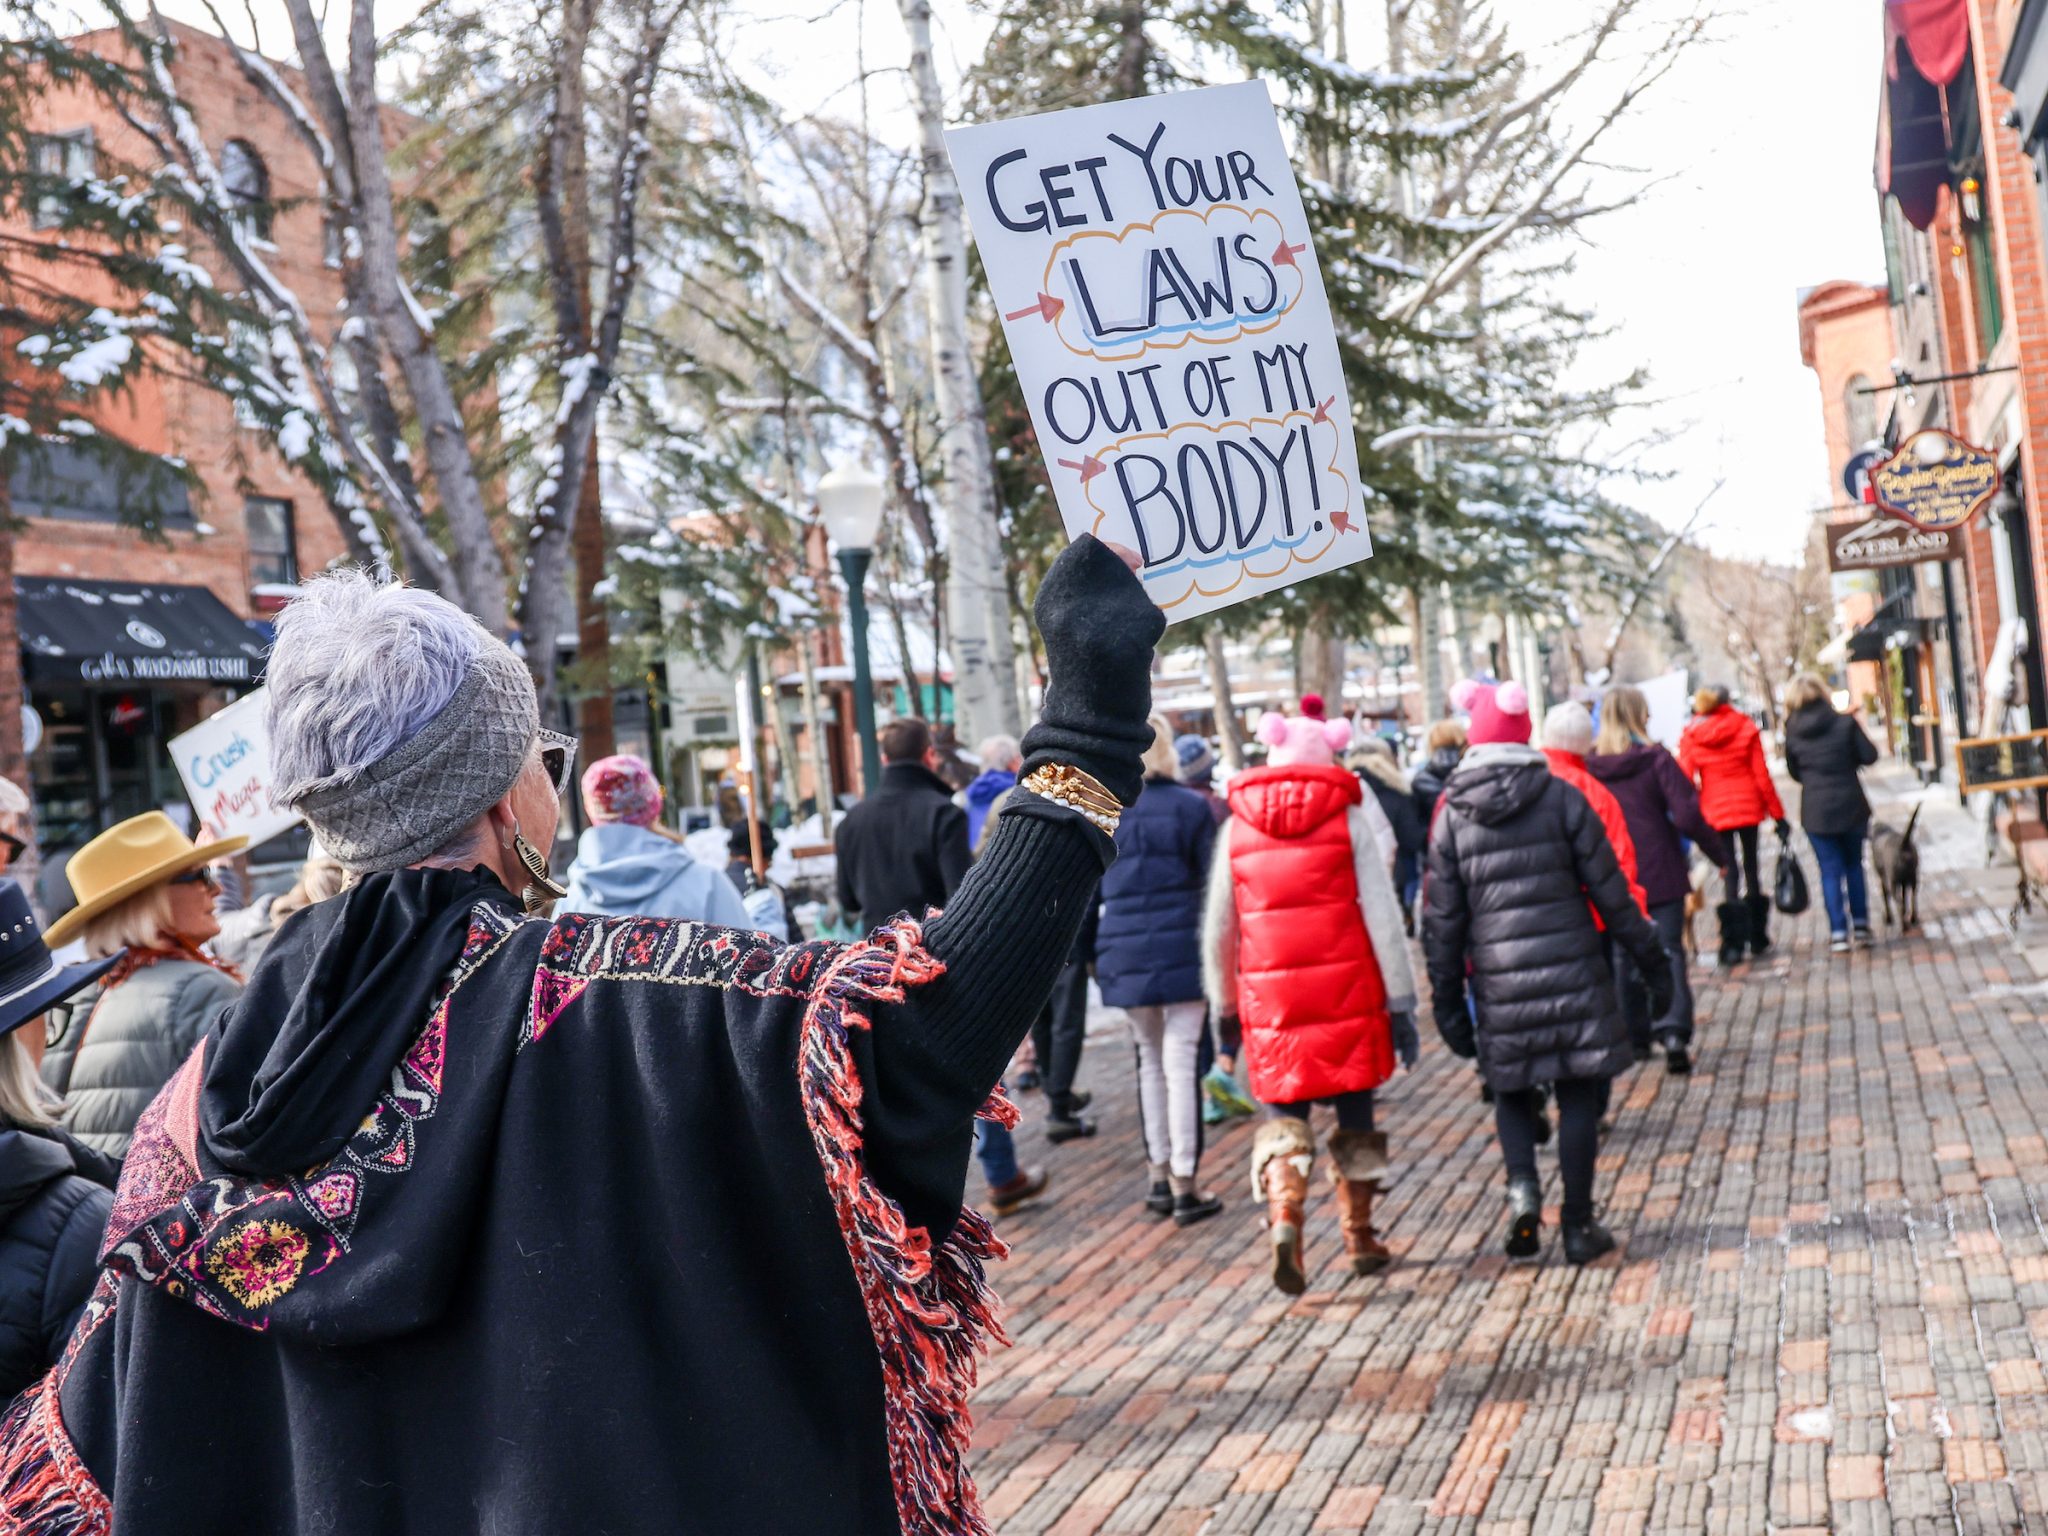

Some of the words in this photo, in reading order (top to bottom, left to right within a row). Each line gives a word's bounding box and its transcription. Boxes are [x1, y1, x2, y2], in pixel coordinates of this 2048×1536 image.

[986, 149, 1113, 235] GET
[1107, 122, 1274, 210] YOUR
[1061, 233, 1278, 336] LAWS
[1045, 365, 1168, 444] OUT
[1184, 356, 1235, 417] OF
[1253, 343, 1315, 412] MY
[1114, 425, 1322, 568] BODY!
[133, 656, 207, 679] MADAME
[208, 656, 249, 679] USHI
[191, 731, 255, 788] Crush
